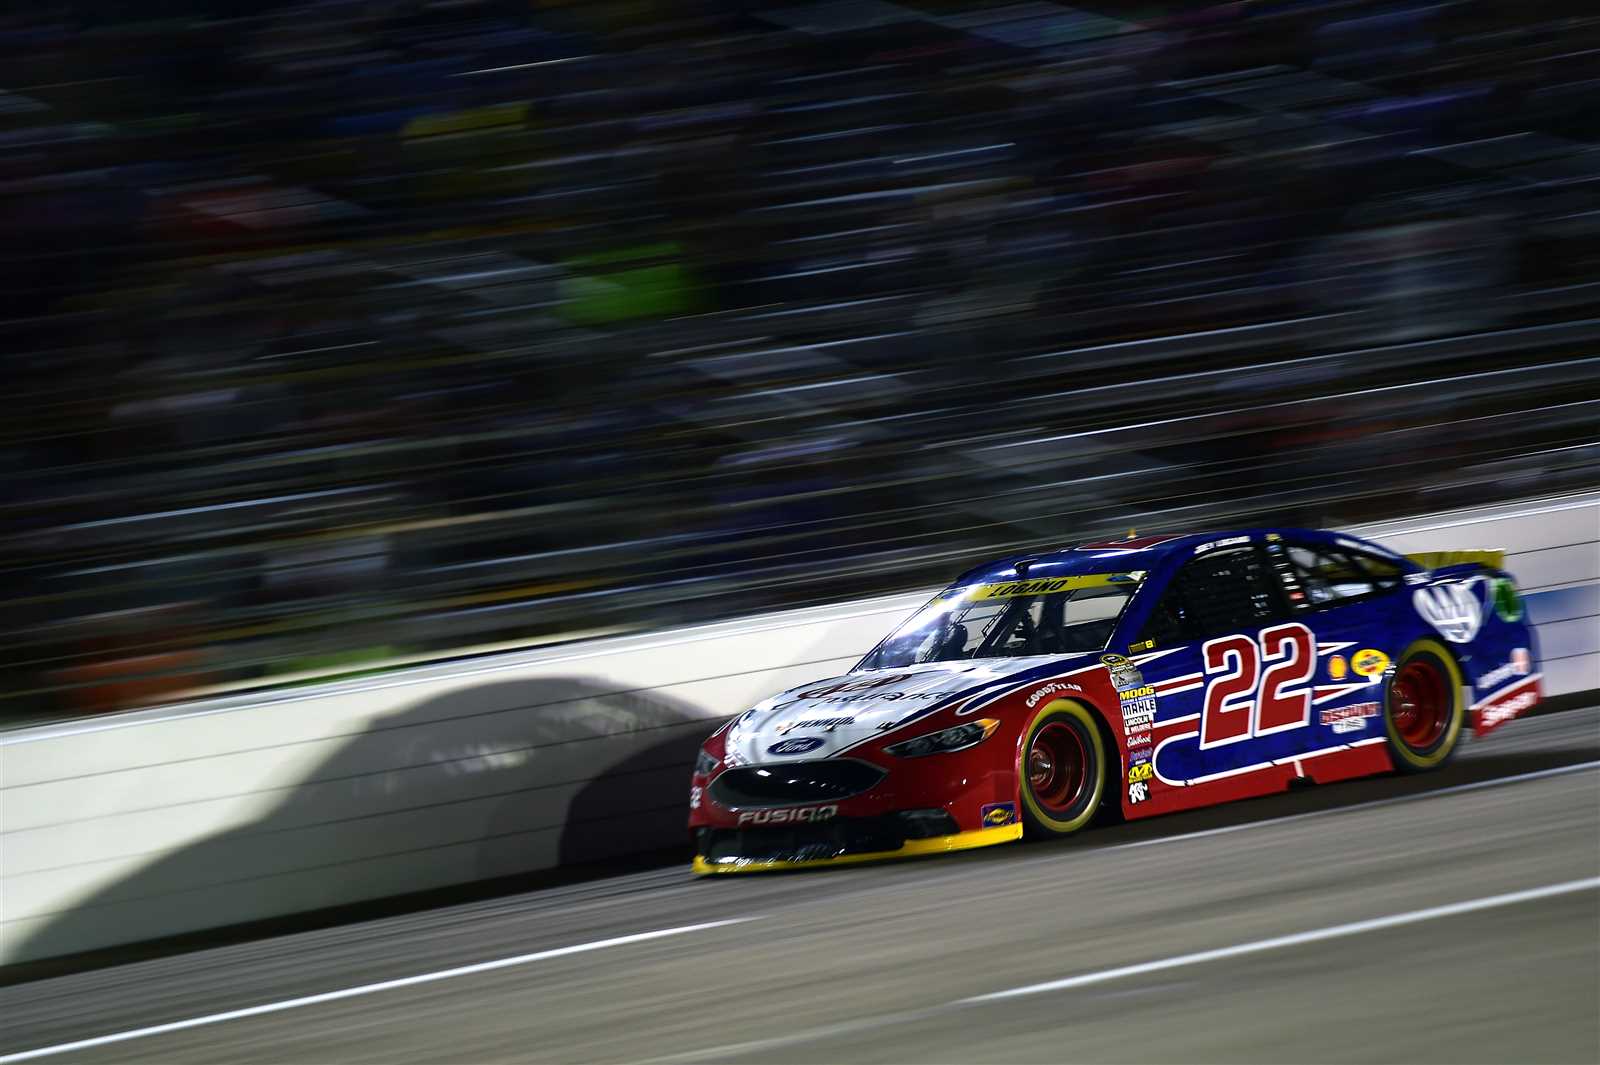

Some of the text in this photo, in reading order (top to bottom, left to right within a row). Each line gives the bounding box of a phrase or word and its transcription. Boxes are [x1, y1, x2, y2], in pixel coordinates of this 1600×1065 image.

[987, 579, 1068, 598] LOGANO
[1025, 682, 1082, 708] GOODYEAR
[1119, 686, 1154, 700] MOOG
[1200, 622, 1316, 750] 22
[1122, 700, 1156, 716] MAHLE
[738, 805, 838, 825] FUSION
